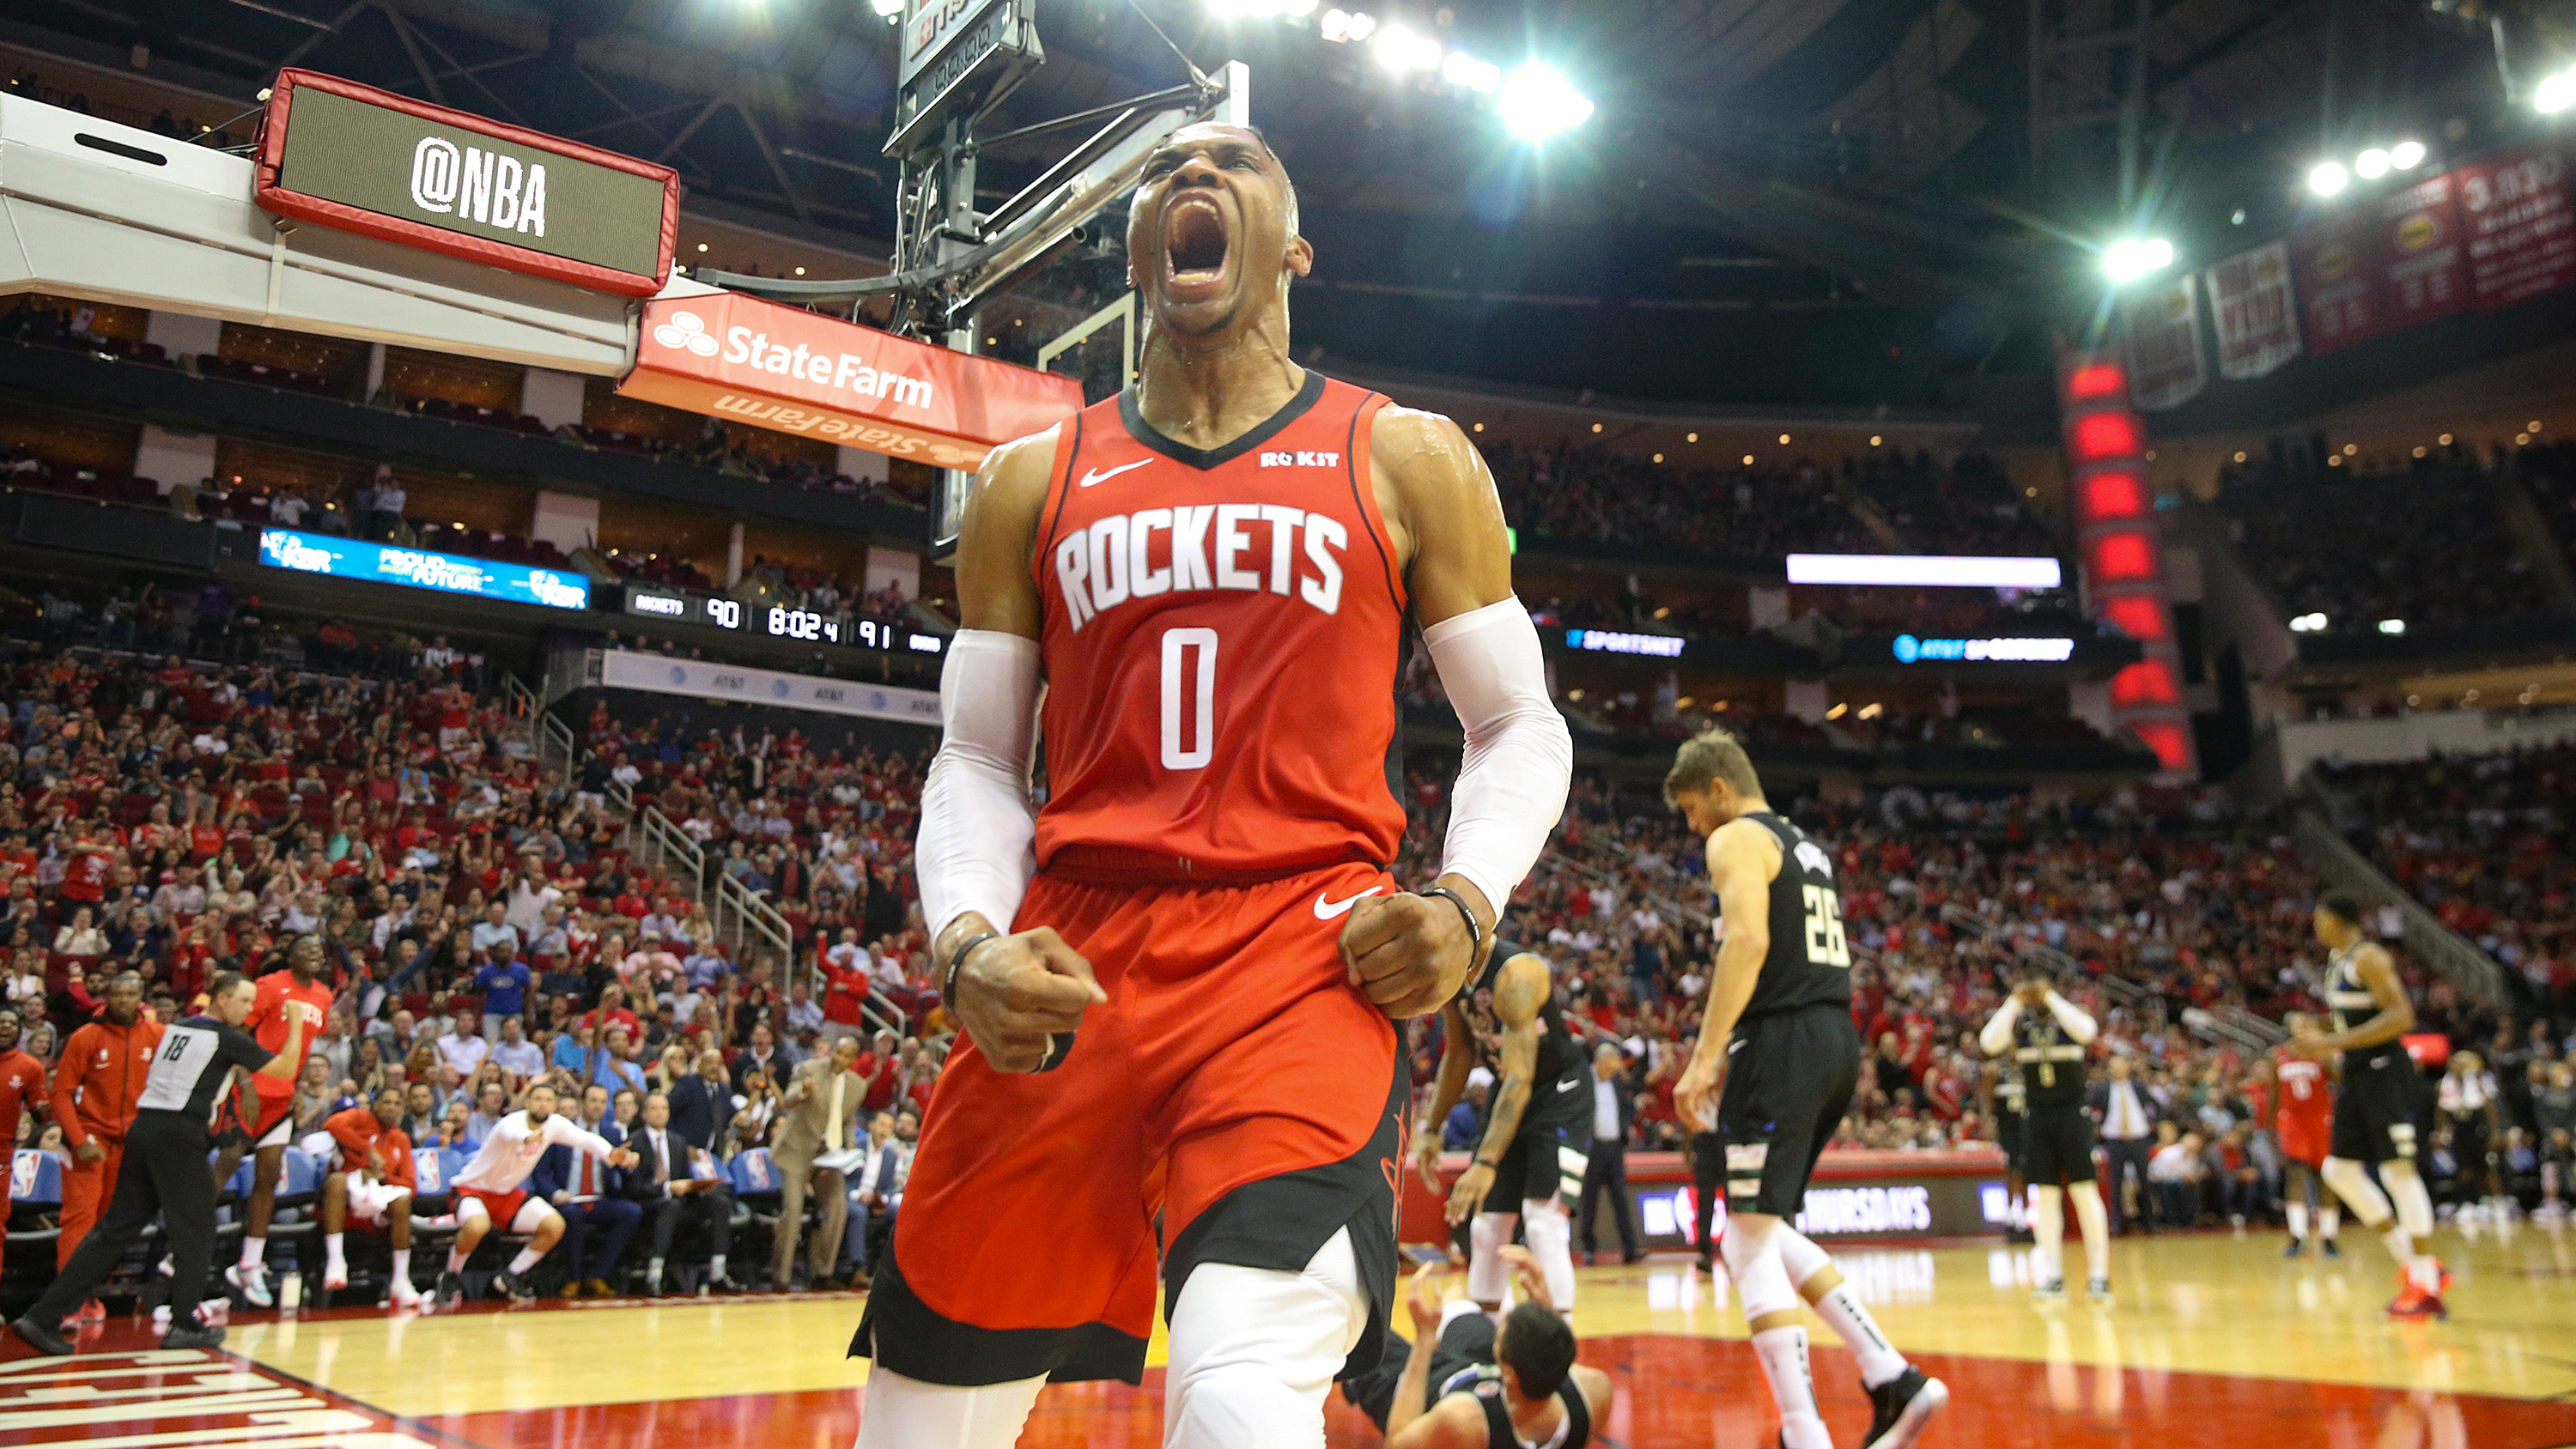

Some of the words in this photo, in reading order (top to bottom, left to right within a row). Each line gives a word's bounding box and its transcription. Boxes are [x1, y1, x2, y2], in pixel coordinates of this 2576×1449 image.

[410, 136, 547, 238] @NBA
[380, 549, 447, 572] PROUD
[1056, 503, 1348, 634] ROCKETS
[412, 567, 483, 592] FUTURE
[707, 598, 739, 629] 90
[769, 607, 821, 640] 8:02
[860, 621, 890, 650] 91
[1161, 627, 1218, 770] 0
[1802, 883, 1851, 968] 26
[163, 1034, 191, 1061] 18
